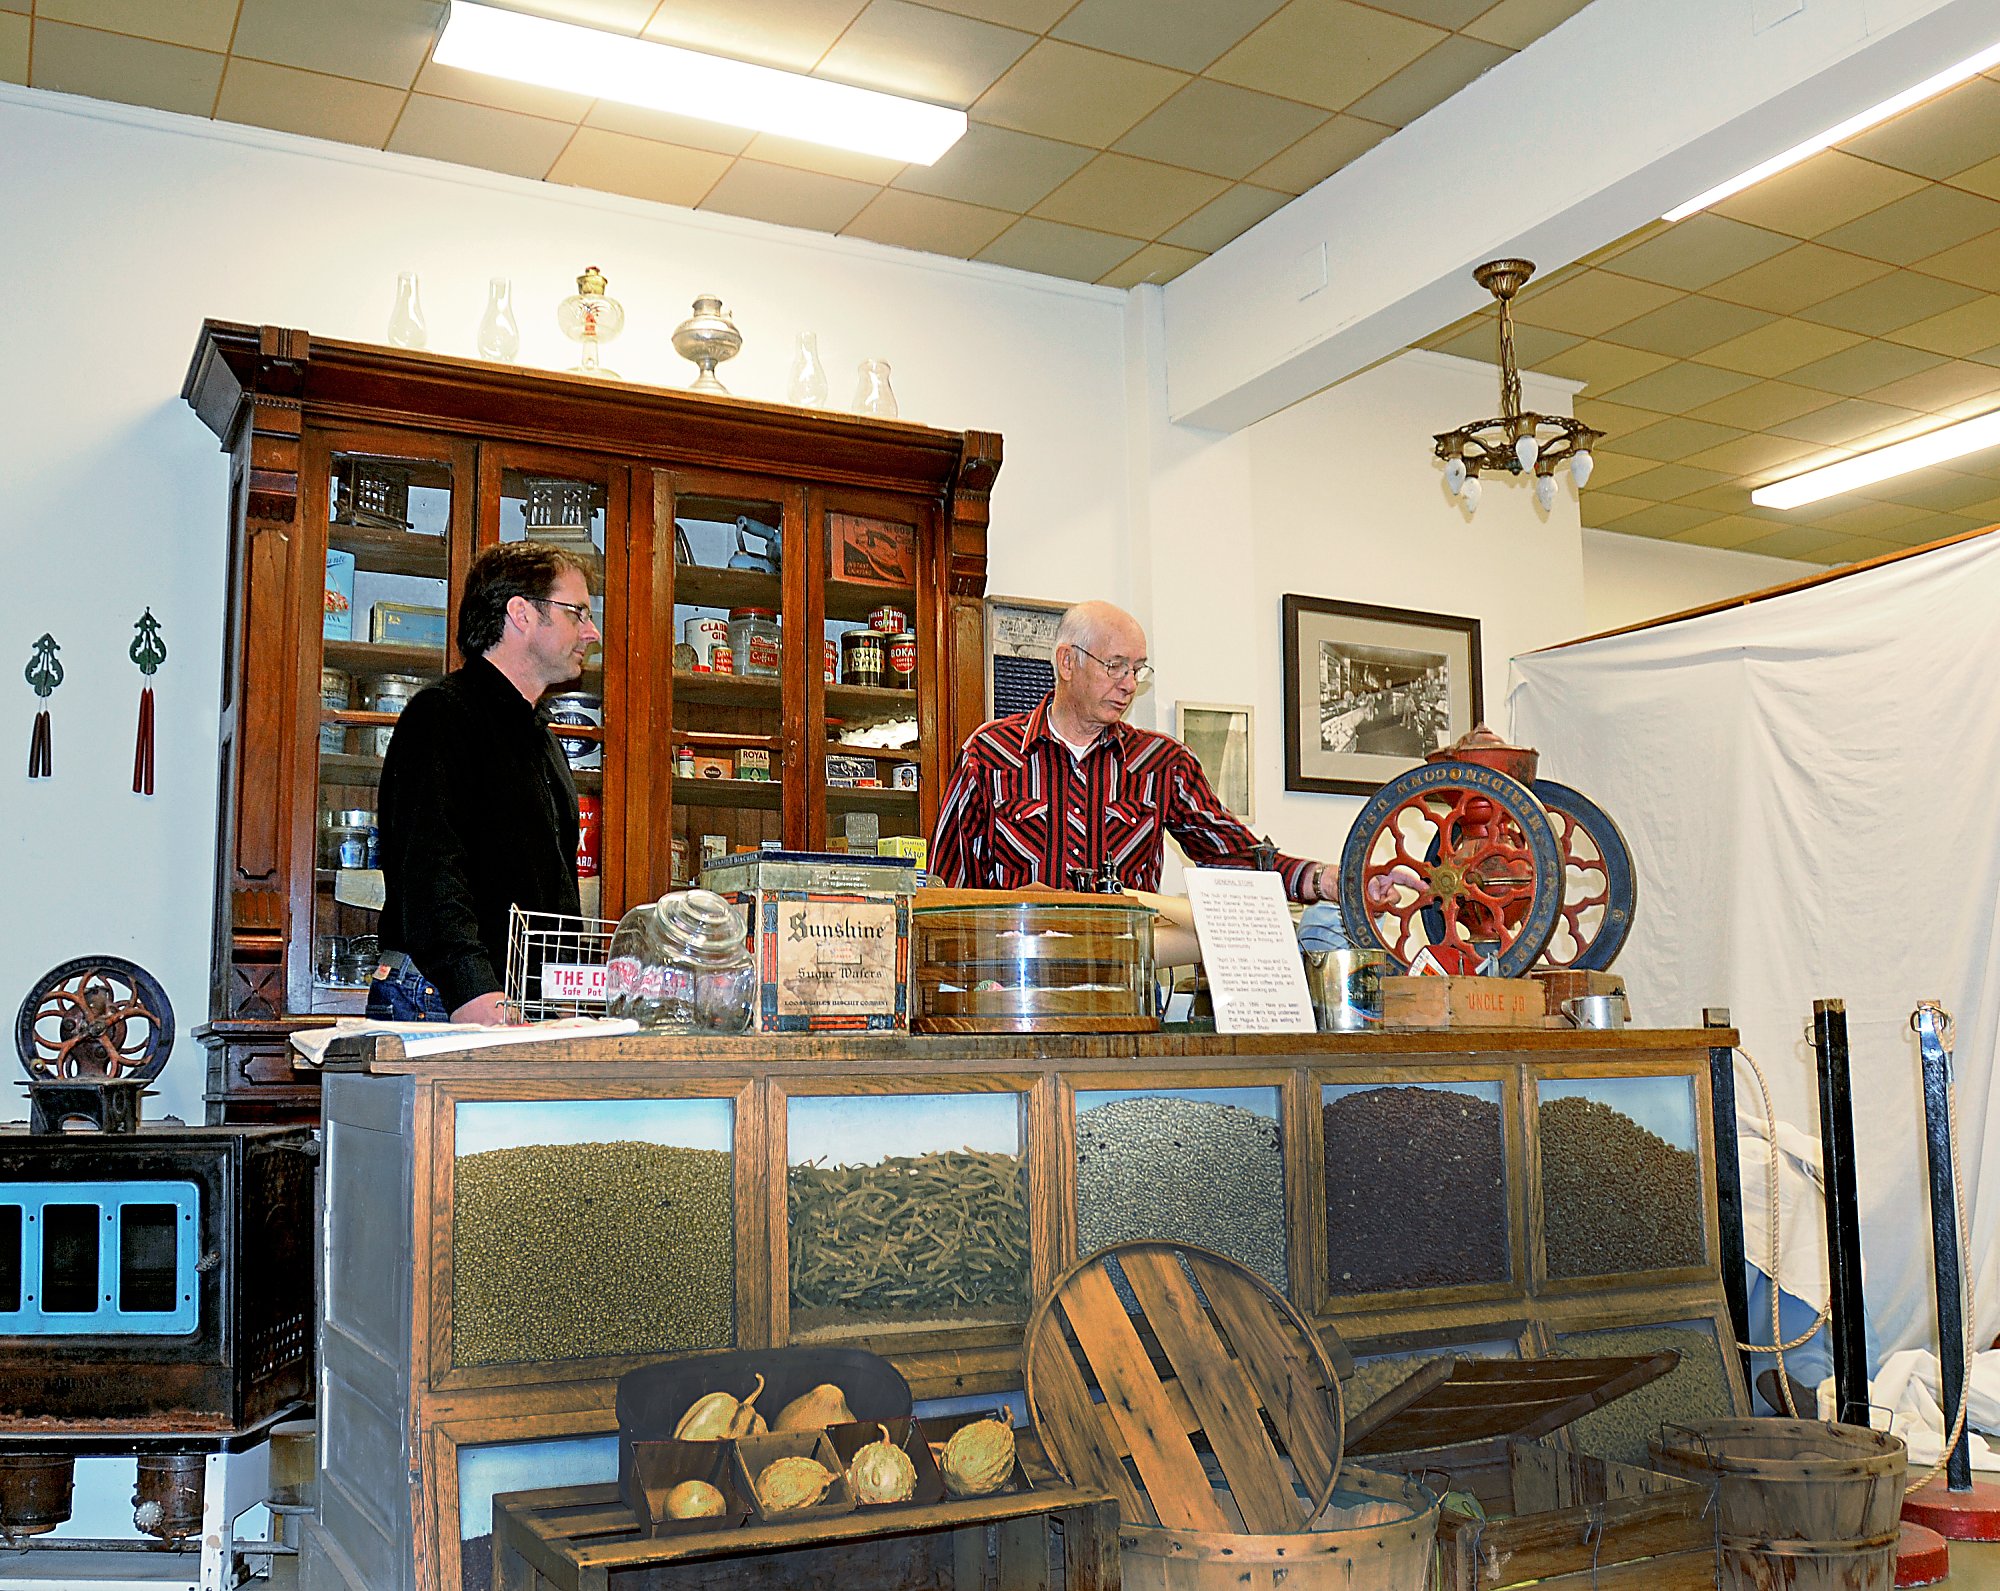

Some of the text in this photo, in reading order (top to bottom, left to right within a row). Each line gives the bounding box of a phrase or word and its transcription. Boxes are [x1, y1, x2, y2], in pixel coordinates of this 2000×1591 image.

[891, 648, 916, 658] BOKA
[743, 751, 767, 760] ROYAL
[1466, 769, 1543, 831] MERIDEN
[579, 812, 593, 820] HY
[577, 827, 587, 852] X
[576, 856, 592, 866] ARD
[788, 909, 886, 942] Sunshine
[554, 971, 606, 986] THE CH
[797, 967, 882, 980] Sugar Wafers
[562, 987, 581, 995] Safe
[1468, 992, 1504, 1011] UNCLE
